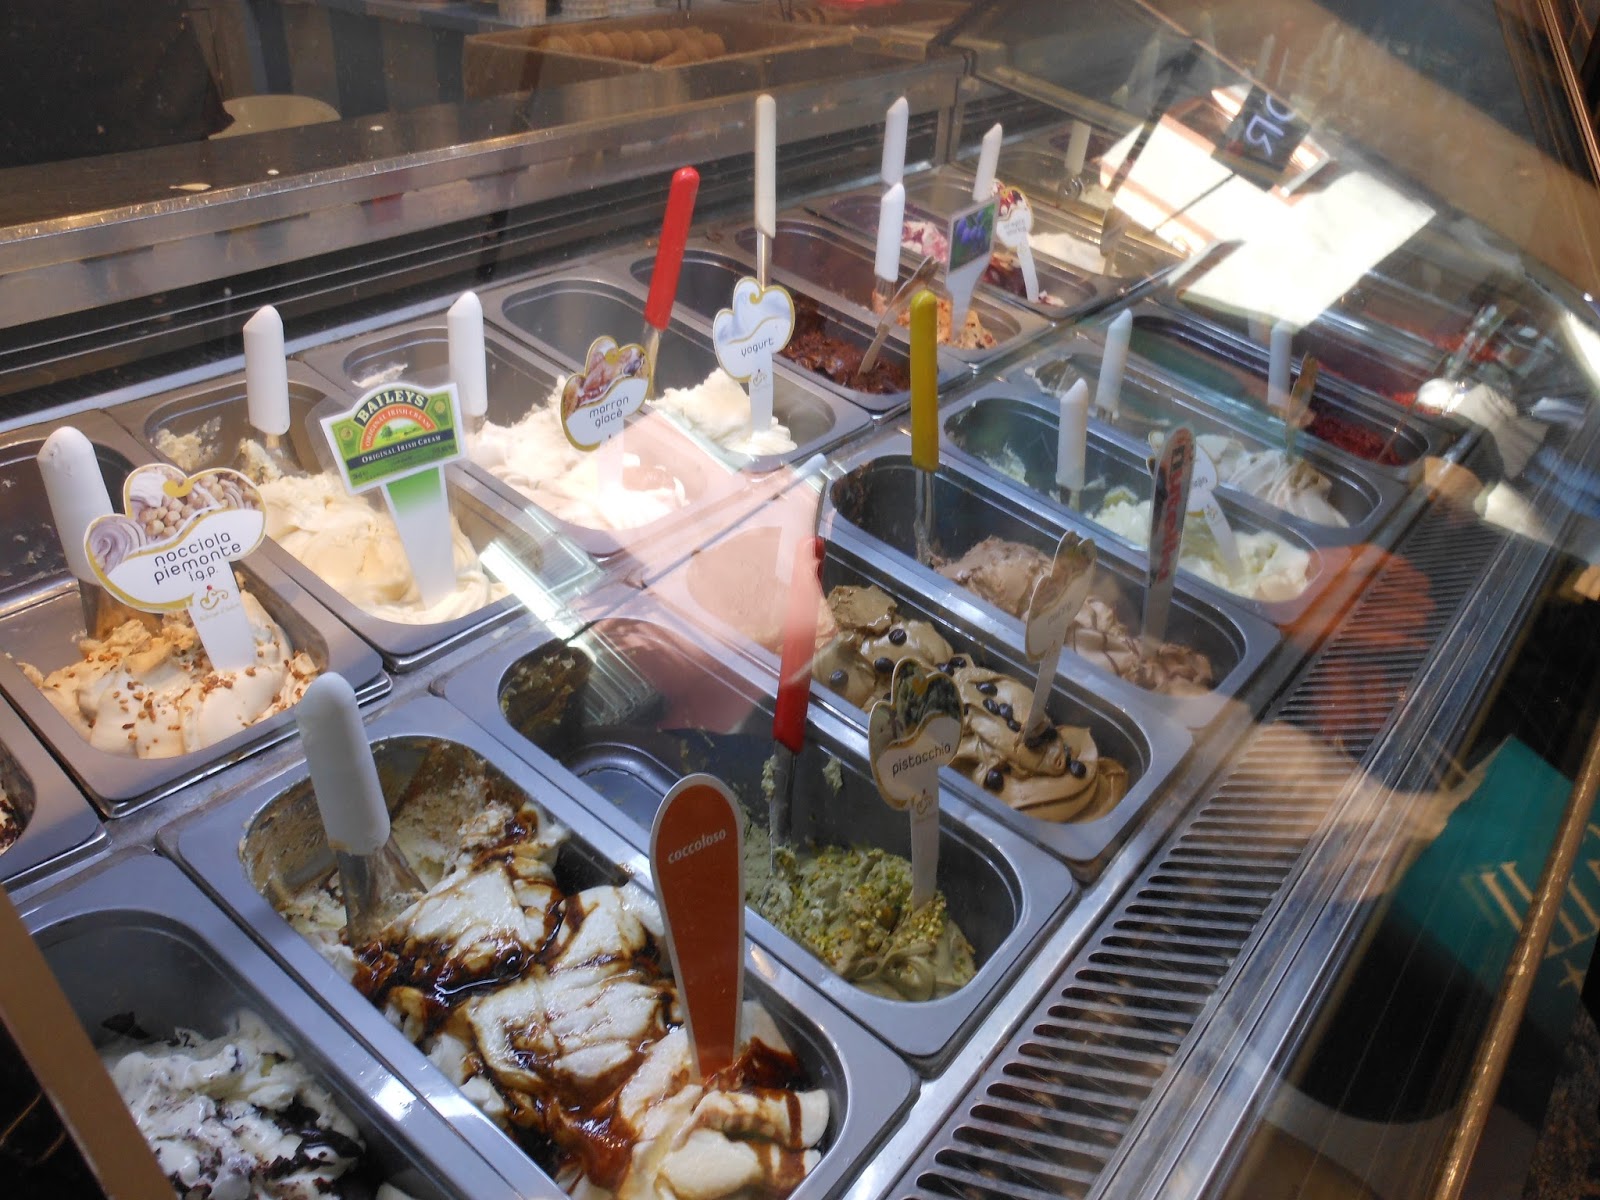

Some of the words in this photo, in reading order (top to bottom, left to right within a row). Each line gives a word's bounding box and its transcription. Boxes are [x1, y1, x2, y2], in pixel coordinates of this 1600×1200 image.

[740, 337, 775, 358] yogurt
[357, 390, 425, 423] BAILEYS
[589, 395, 629, 419] marron
[366, 413, 387, 447] ORIGINAL
[387, 408, 409, 417] IRISH
[409, 409, 432, 429] CREAM
[361, 447, 396, 464] ORIGINAL
[396, 441, 417, 452] IRISH
[417, 435, 441, 446] CREAM
[153, 531, 232, 567] nocciola
[153, 543, 242, 586] piemonte
[891, 741, 951, 778] pistacchio
[667, 828, 727, 865] coccoloso
